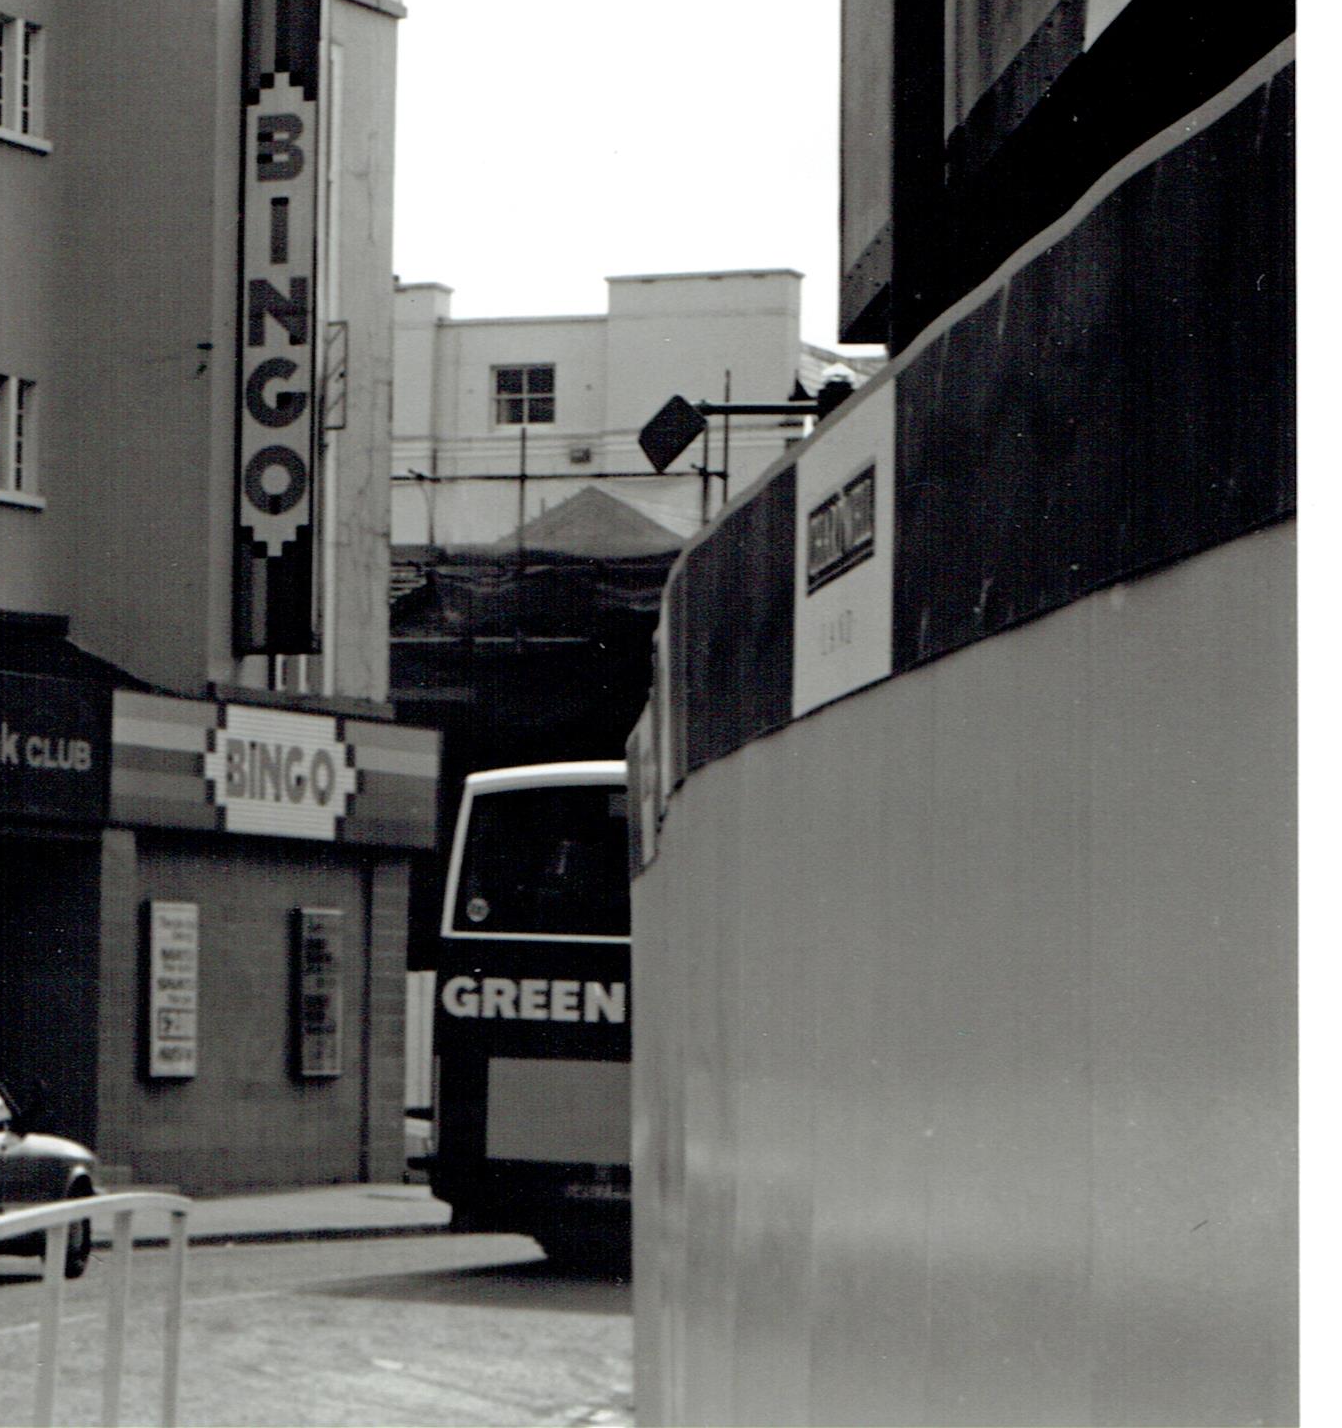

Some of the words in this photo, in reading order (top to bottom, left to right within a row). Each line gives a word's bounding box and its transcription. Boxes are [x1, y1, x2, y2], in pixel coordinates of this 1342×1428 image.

[244, 113, 309, 516] BINGO
[26, 735, 92, 771] CLUB
[226, 738, 335, 807] BINGO
[442, 975, 626, 1023] GREEN
